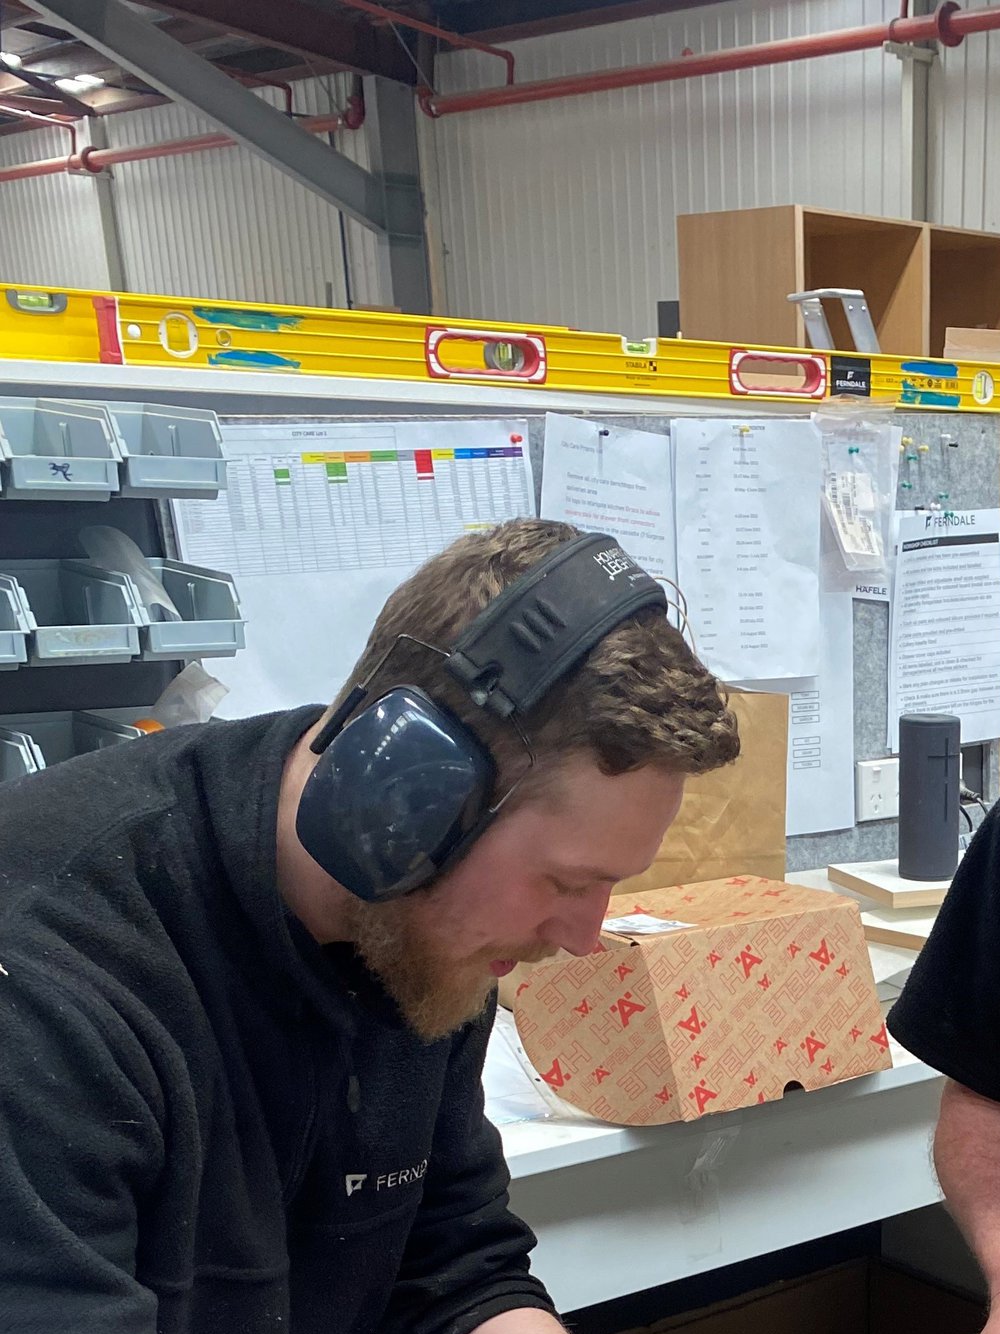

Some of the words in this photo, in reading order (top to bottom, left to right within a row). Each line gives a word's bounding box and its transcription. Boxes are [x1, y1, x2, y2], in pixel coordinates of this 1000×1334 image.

[836, 379, 866, 389] FERNDALE
[934, 514, 976, 528] FERNDALE
[376, 1159, 428, 1192] FERND
